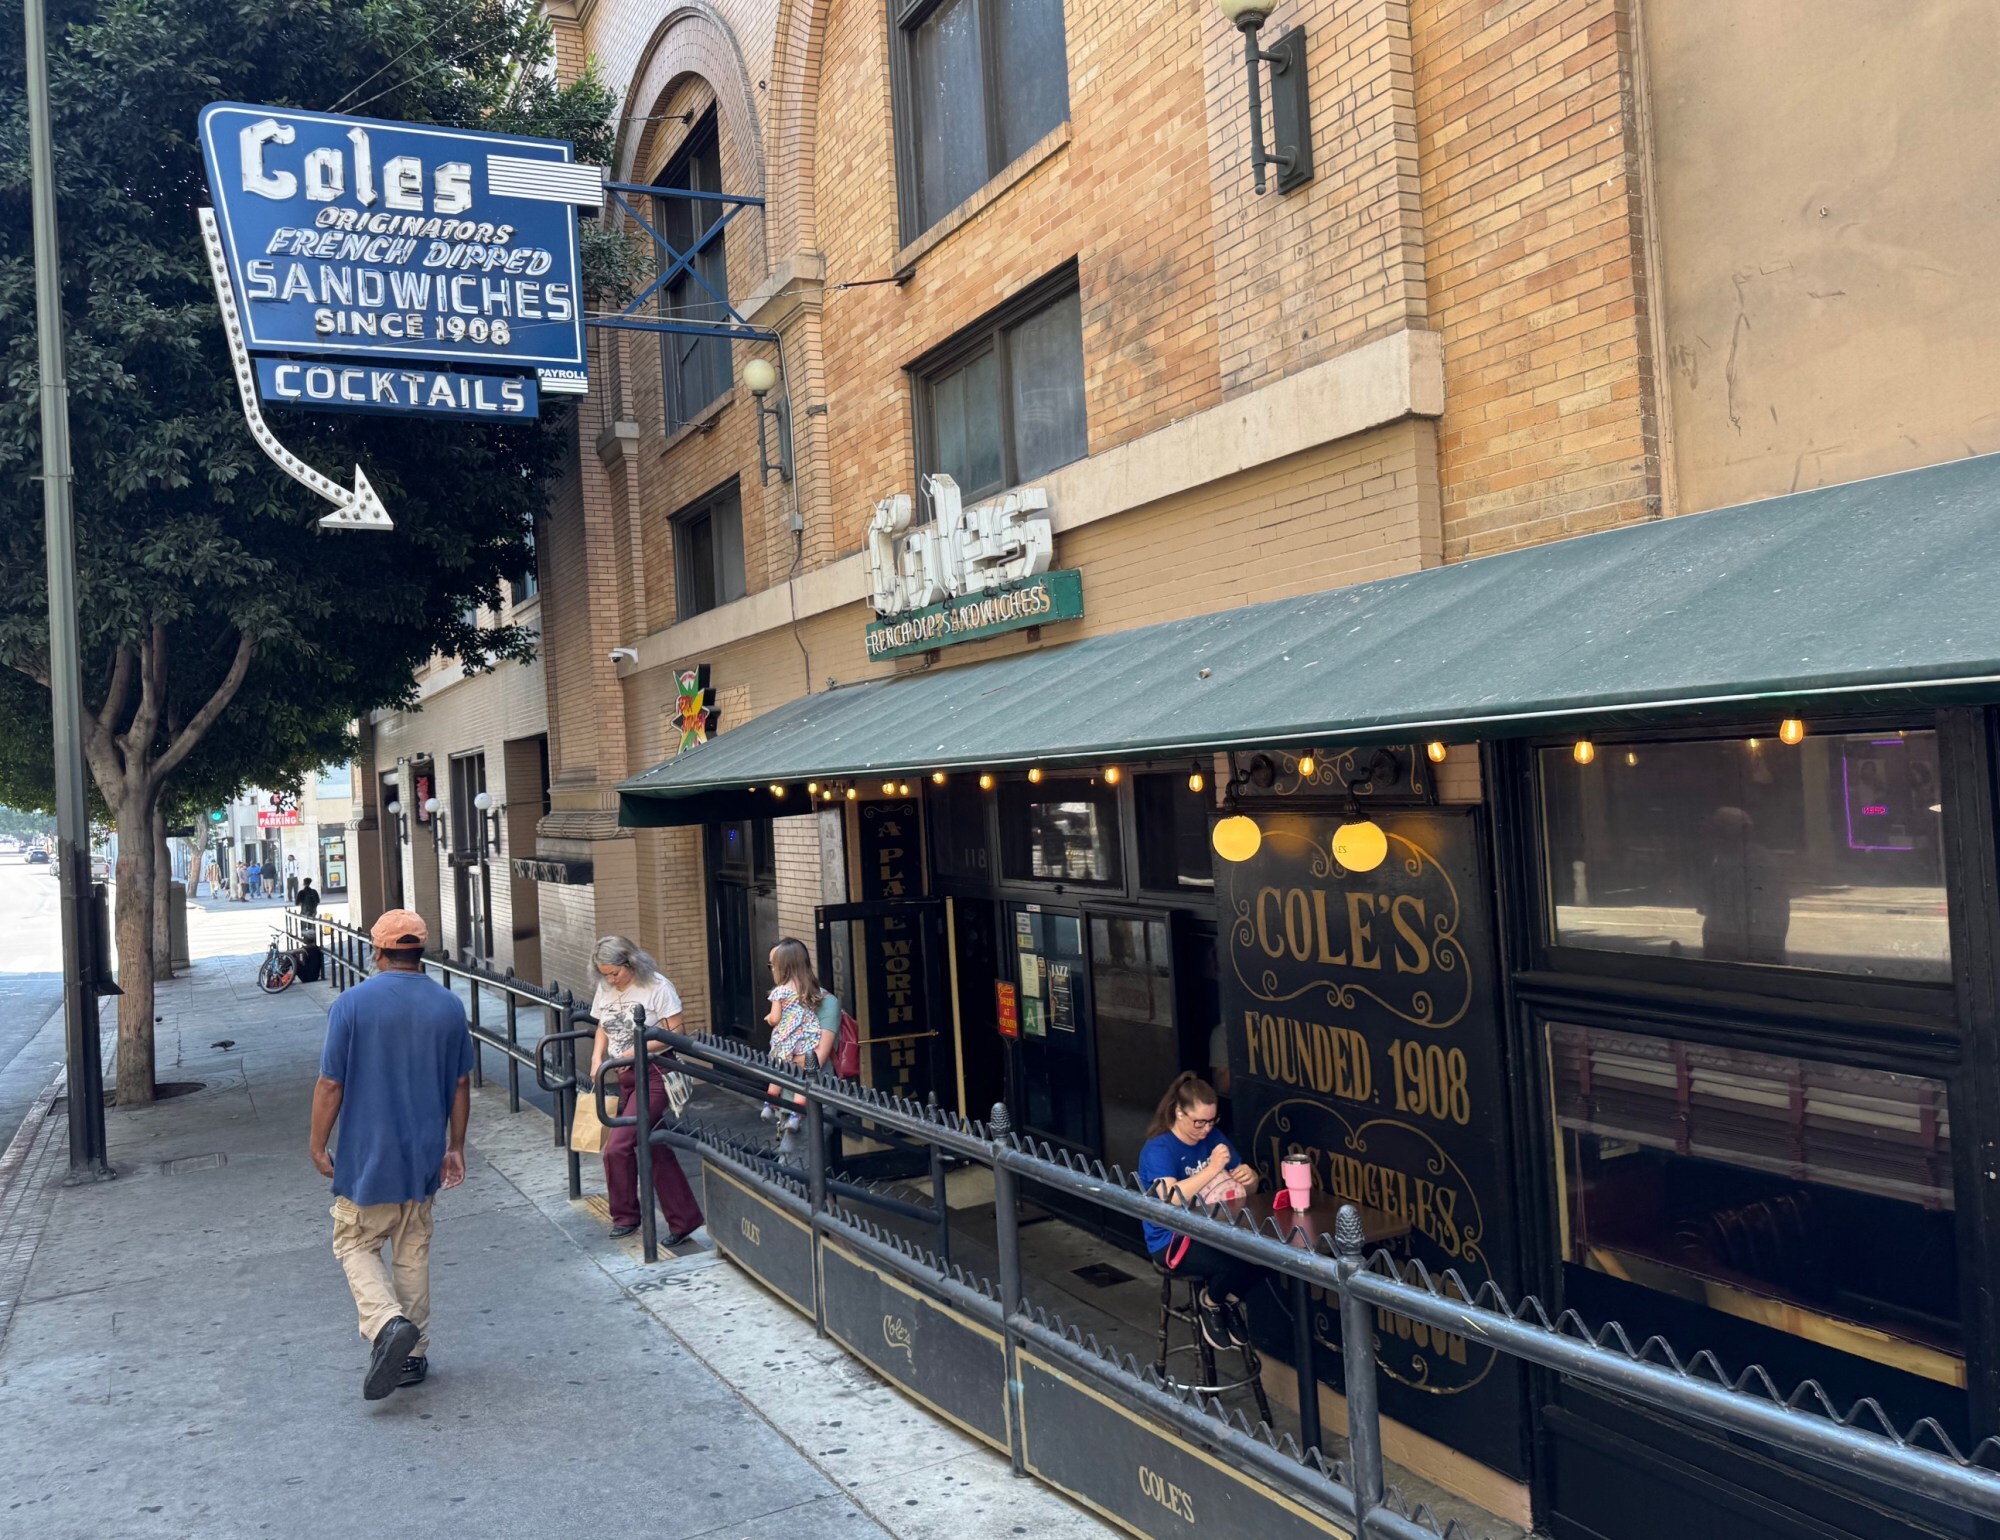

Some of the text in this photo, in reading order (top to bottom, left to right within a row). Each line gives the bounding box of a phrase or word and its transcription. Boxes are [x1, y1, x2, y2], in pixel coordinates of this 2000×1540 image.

[240, 119, 472, 214] Coles
[315, 207, 516, 244] ORIGINATORS
[266, 227, 551, 276] FRENCH DIPPED
[247, 259, 572, 321] SANDWICHES
[315, 308, 512, 345] SINCE 1908
[275, 365, 526, 412] COCKTAILS
[537, 367, 588, 380] PAYROLL
[260, 816, 297, 826] PARKING
[877, 821, 902, 838] A
[964, 847, 987, 869] 118
[879, 847, 908, 931] PLAE
[1256, 886, 1430, 975] COLE'S
[880, 939, 913, 1024] WORTH
[1051, 963, 1069, 977] JAZZ
[1387, 1038, 1471, 1126] 1908
[1328, 1151, 1460, 1258] ANGELES
[1138, 1465, 1196, 1524] COLE'S
